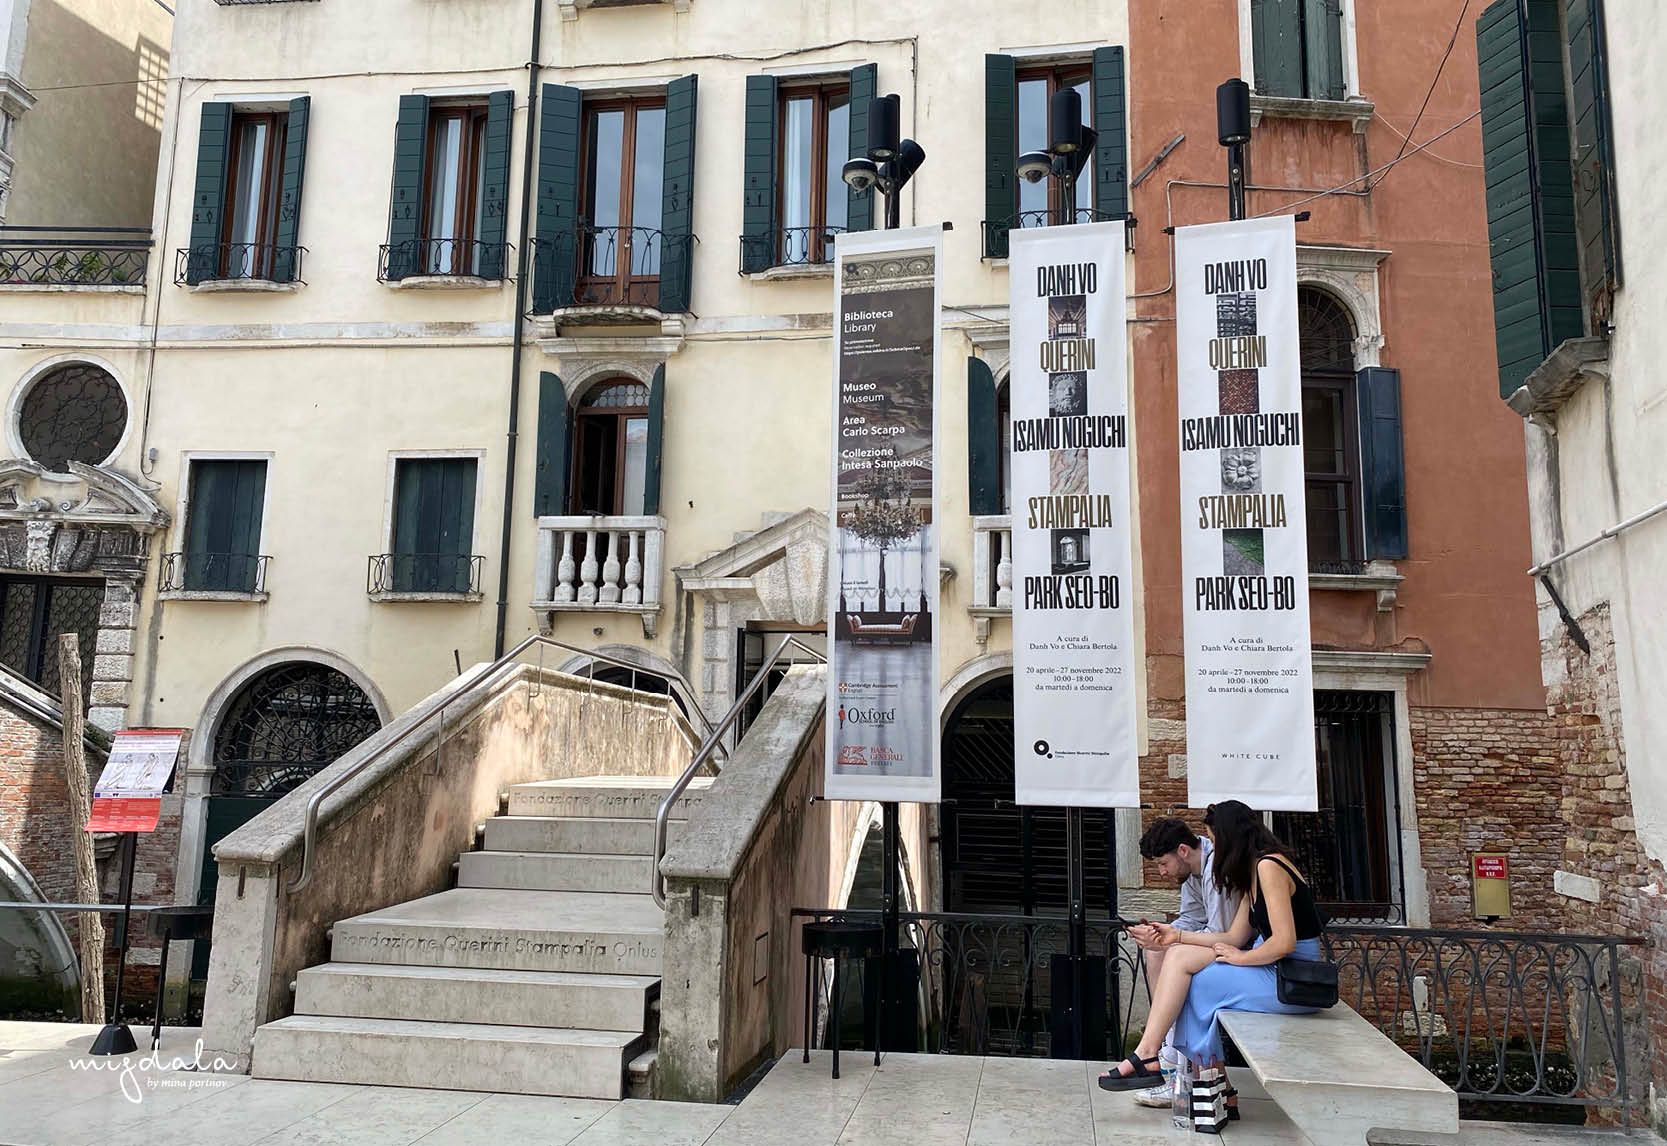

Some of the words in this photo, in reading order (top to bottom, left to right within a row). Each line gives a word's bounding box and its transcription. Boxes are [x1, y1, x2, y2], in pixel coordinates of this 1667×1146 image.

[1037, 264, 1076, 297] DANH
[1078, 262, 1097, 295] VO
[1204, 260, 1245, 295] DANH
[1247, 258, 1267, 291] VO
[844, 310, 894, 322] Biblioteca
[844, 323, 876, 333] Library
[1040, 338, 1096, 372] QUERINI
[1209, 335, 1267, 370] QUERINI
[843, 382, 877, 392] Museo
[843, 394, 885, 404] Museum
[843, 416, 866, 425] Area
[842, 427, 869, 437] Carlo
[871, 426, 906, 436] Scarpa
[1013, 416, 1060, 452] ISAMU
[1063, 415, 1126, 449] NOGUCHI
[1182, 414, 1230, 451] ISAMU
[1233, 412, 1300, 448] NOGUCHI
[842, 448, 894, 459] Collezione
[842, 460, 872, 471] Intesa
[874, 458, 923, 470] Sanpaolo
[1028, 494, 1113, 530] STAMPALIA
[1198, 494, 1287, 530] STAMPALIA
[1024, 576, 1063, 610] PARK
[1065, 575, 1120, 609] SEO-BO
[1195, 577, 1236, 611] PARK
[1238, 575, 1296, 611] SEO-BO
[1081, 634, 1089, 642] di
[1255, 636, 1264, 644] di
[1036, 666, 1056, 675] aprile
[1208, 669, 1229, 678] aprile
[1035, 683, 1044, 691] da
[1254, 686, 1289, 694] domenica
[848, 707, 896, 724] Oxford
[339, 931, 437, 950] Fondazione
[444, 935, 508, 952] Querini
[515, 937, 607, 958] Stampalia
